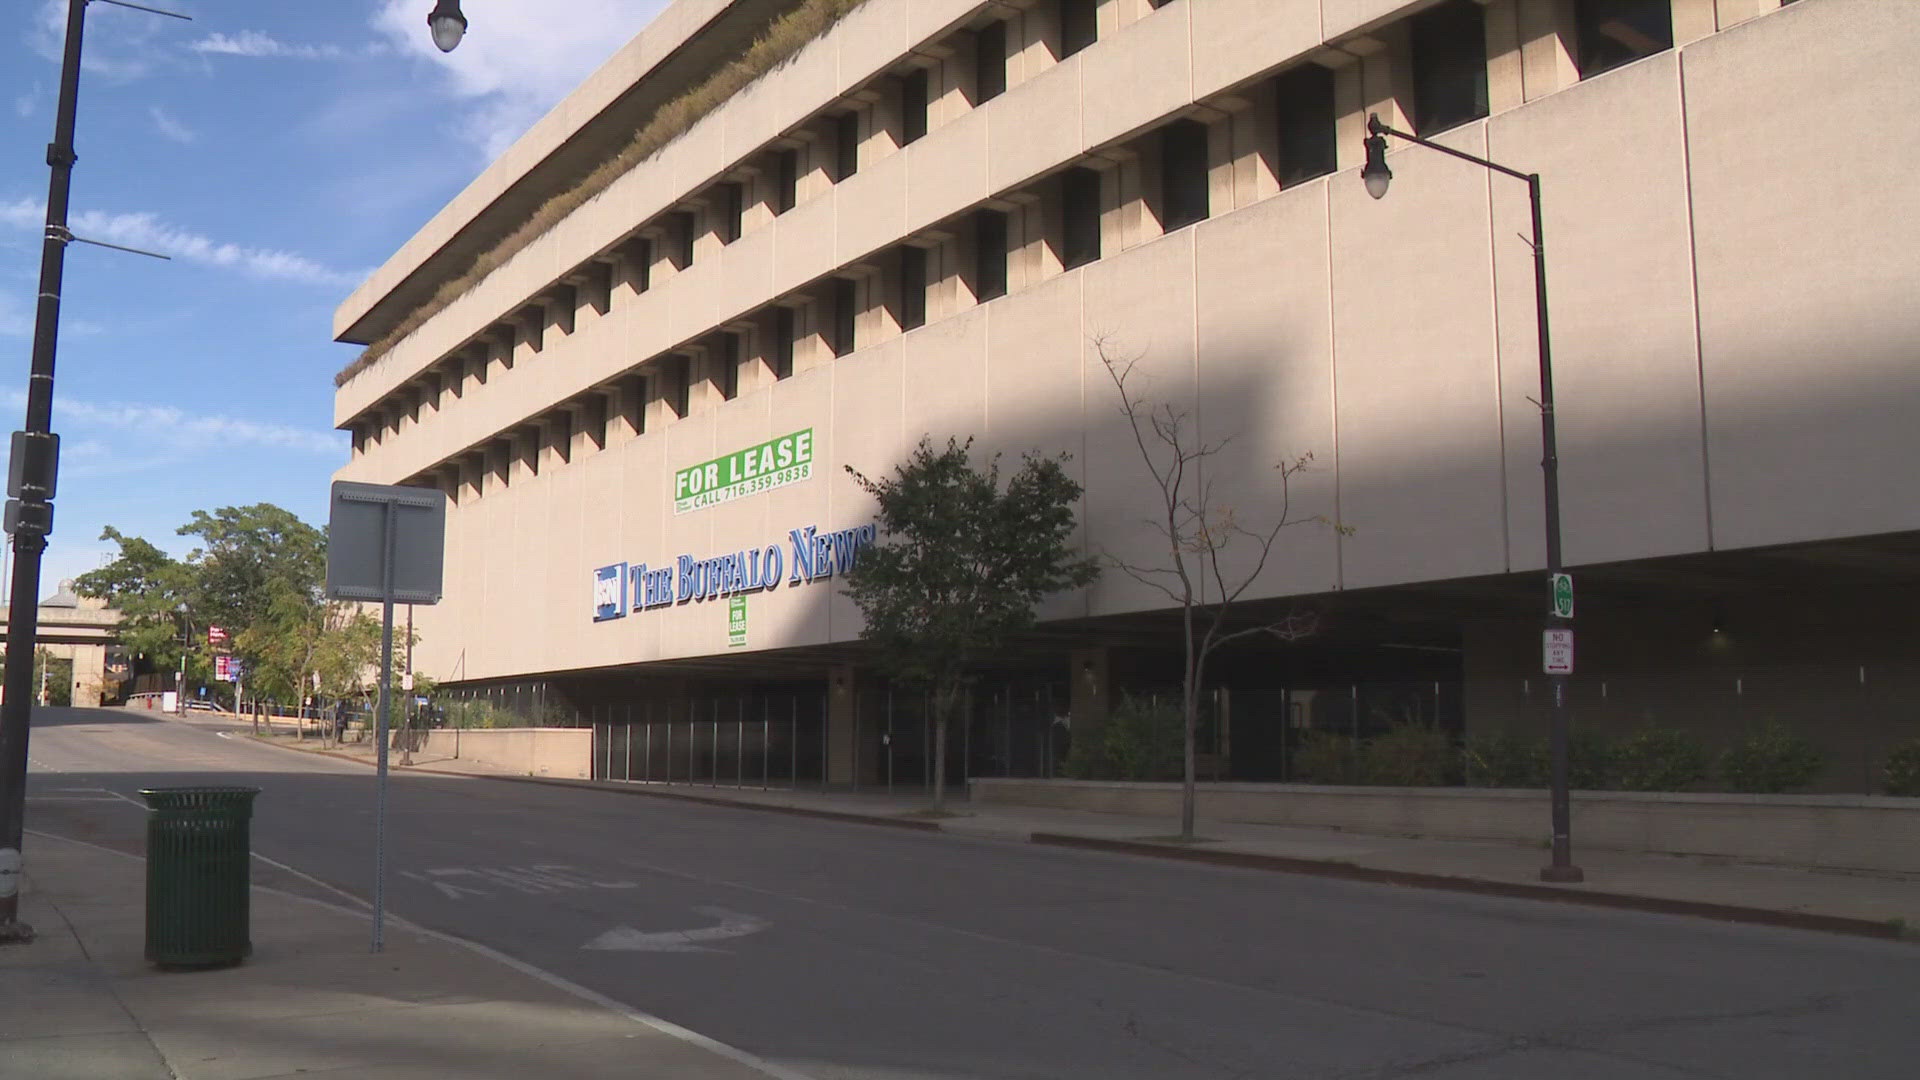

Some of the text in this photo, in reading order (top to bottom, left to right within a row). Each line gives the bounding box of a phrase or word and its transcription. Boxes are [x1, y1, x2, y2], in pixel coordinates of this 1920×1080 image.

[677, 432, 811, 499] FOR LEASE
[694, 491, 721, 508] CALL
[724, 464, 809, 500] 716.359.9838
[629, 563, 673, 610] THE
[676, 544, 783, 603] BUFFALO
[730, 620, 746, 632] LEASE
[731, 609, 743, 621] FOR
[1552, 633, 1564, 641] NO
